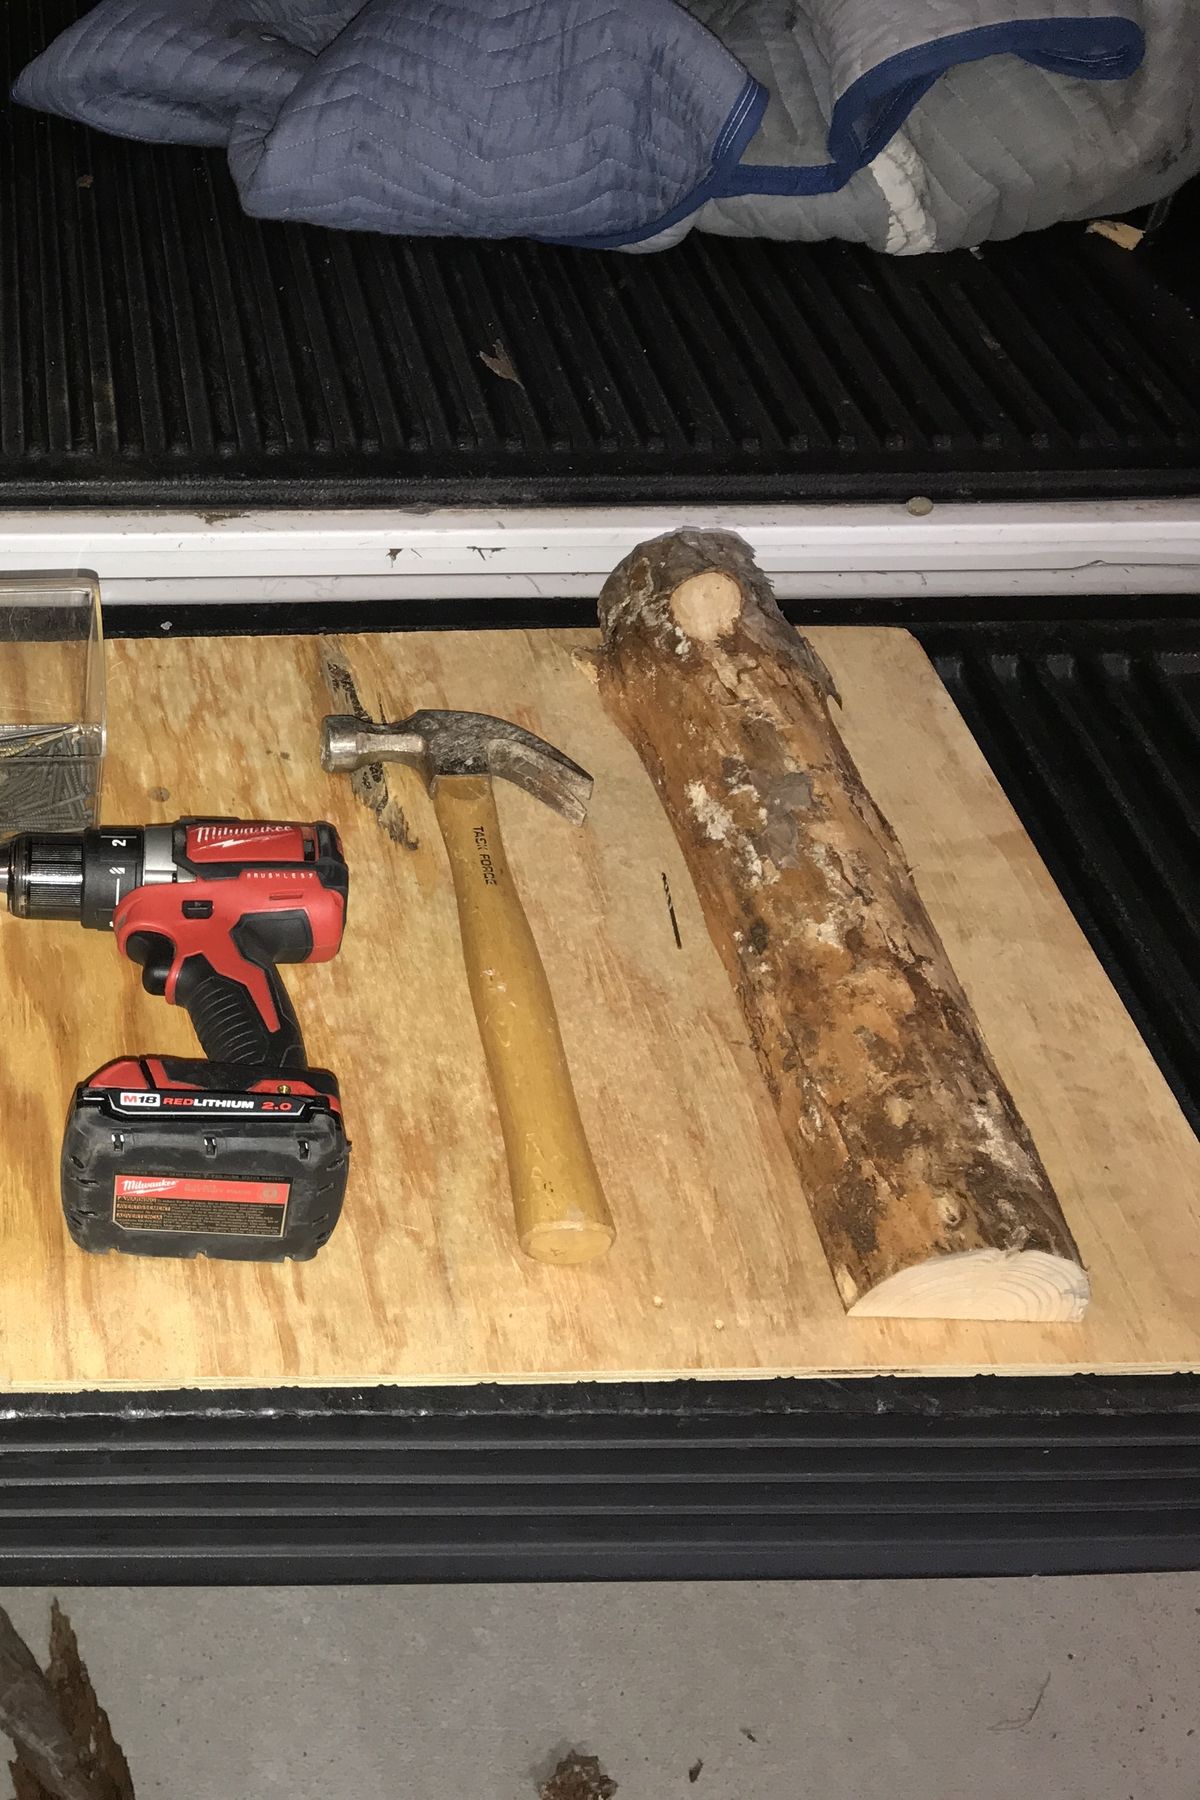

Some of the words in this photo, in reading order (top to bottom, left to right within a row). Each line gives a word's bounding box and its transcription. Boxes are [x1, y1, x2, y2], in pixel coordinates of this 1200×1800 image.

[190, 825, 294, 843] Milwaukee
[111, 839, 126, 847] 2
[123, 1095, 157, 1104] M18
[162, 1097, 255, 1109] REDLITHIUM
[261, 1102, 293, 1110] 2.0
[121, 1179, 179, 1191] Milwaukee
